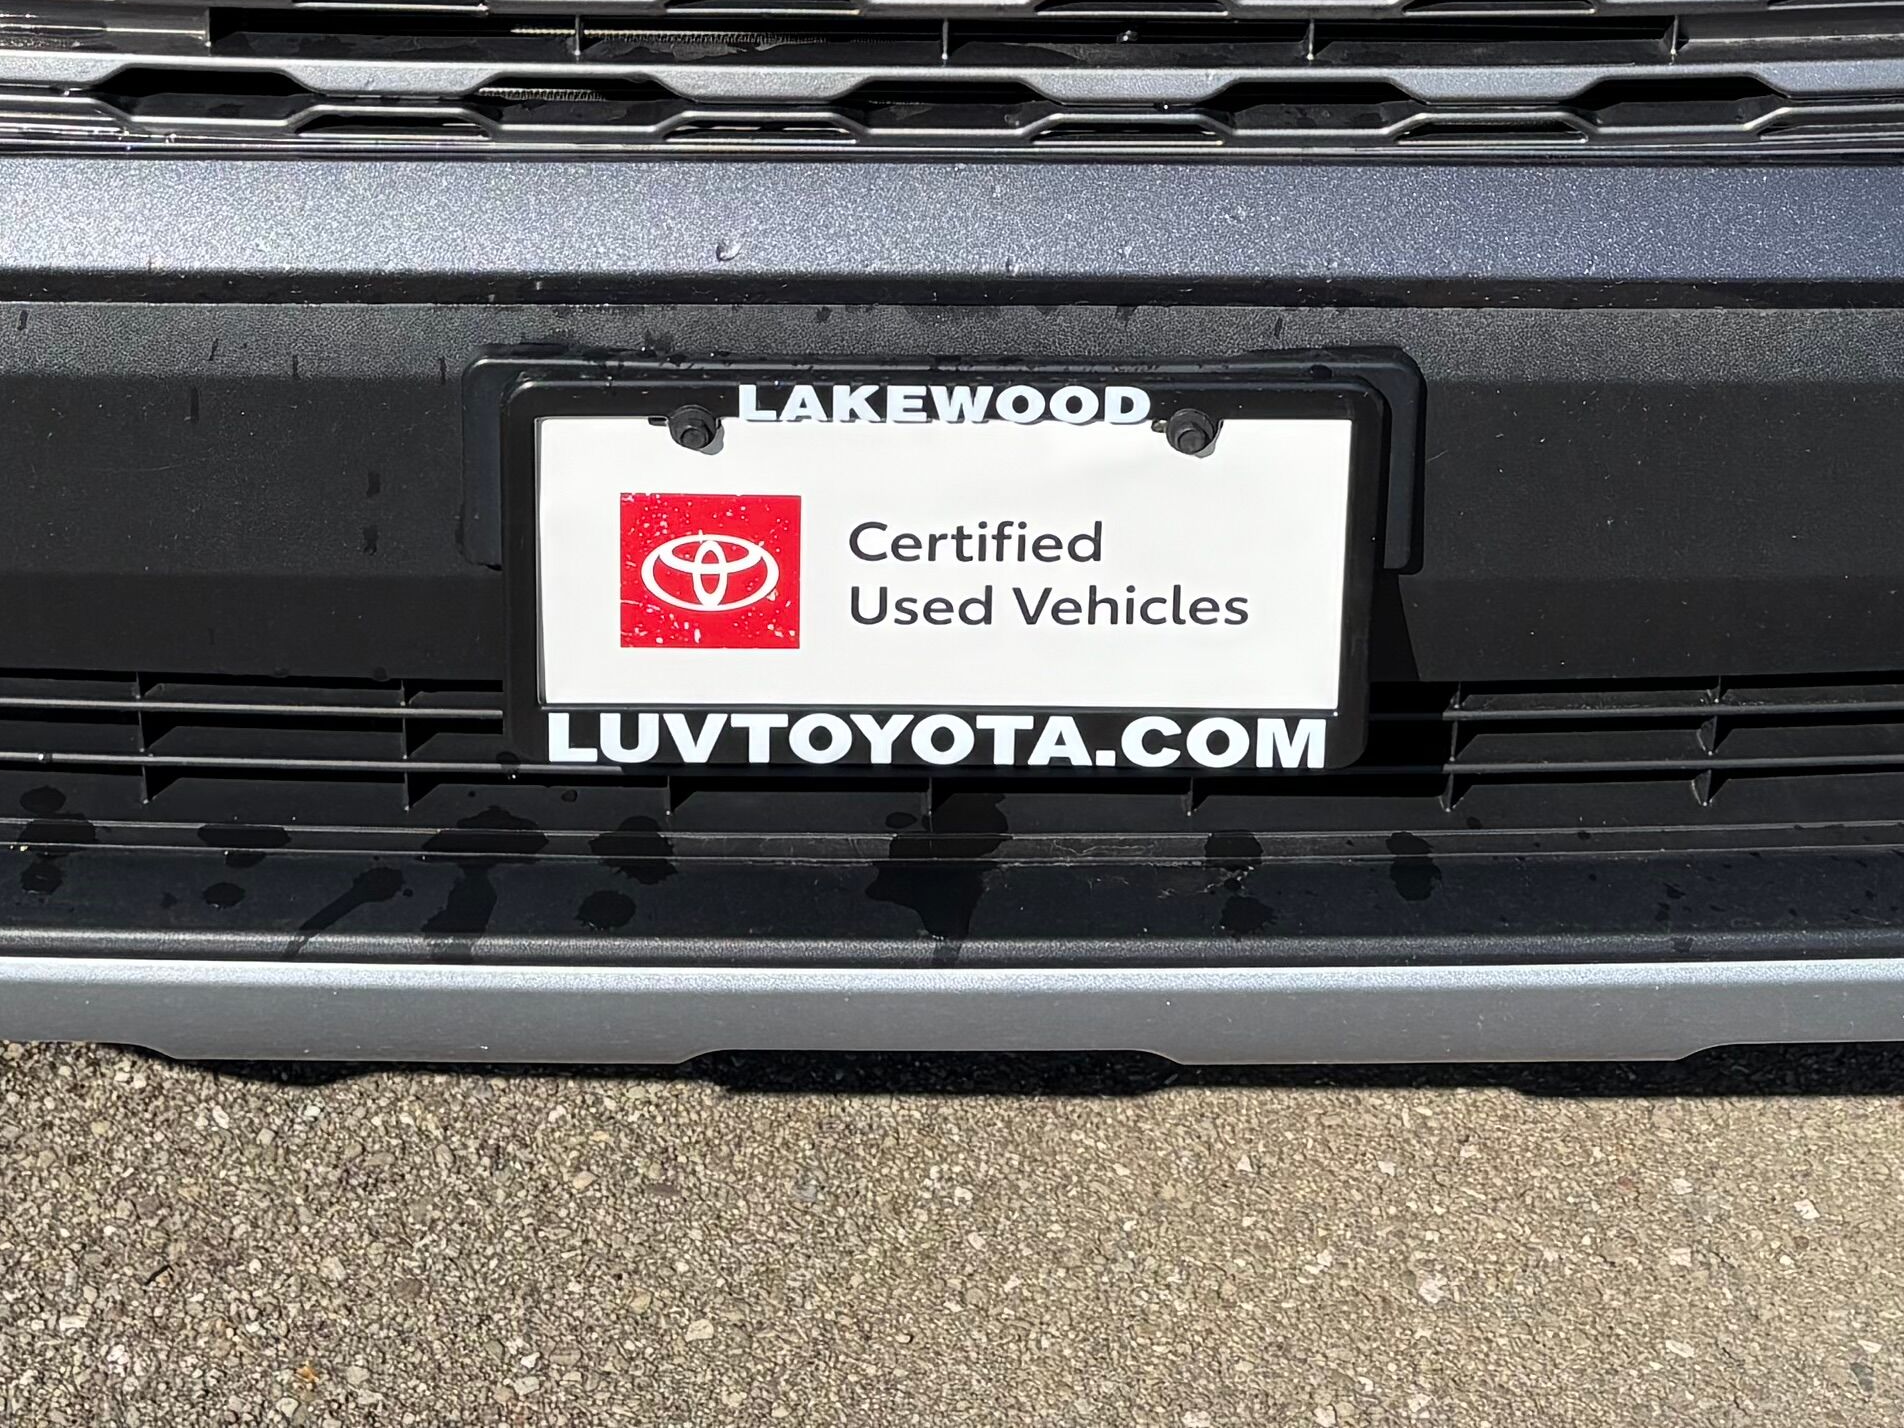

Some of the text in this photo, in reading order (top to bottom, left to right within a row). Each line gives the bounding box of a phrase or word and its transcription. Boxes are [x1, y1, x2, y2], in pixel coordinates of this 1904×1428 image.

[737, 384, 1152, 425] LAKEWOOD
[848, 521, 1103, 563] Certified
[849, 585, 1249, 627] Used Vehicles
[547, 712, 1326, 770] LUVTOYOTA.COM
